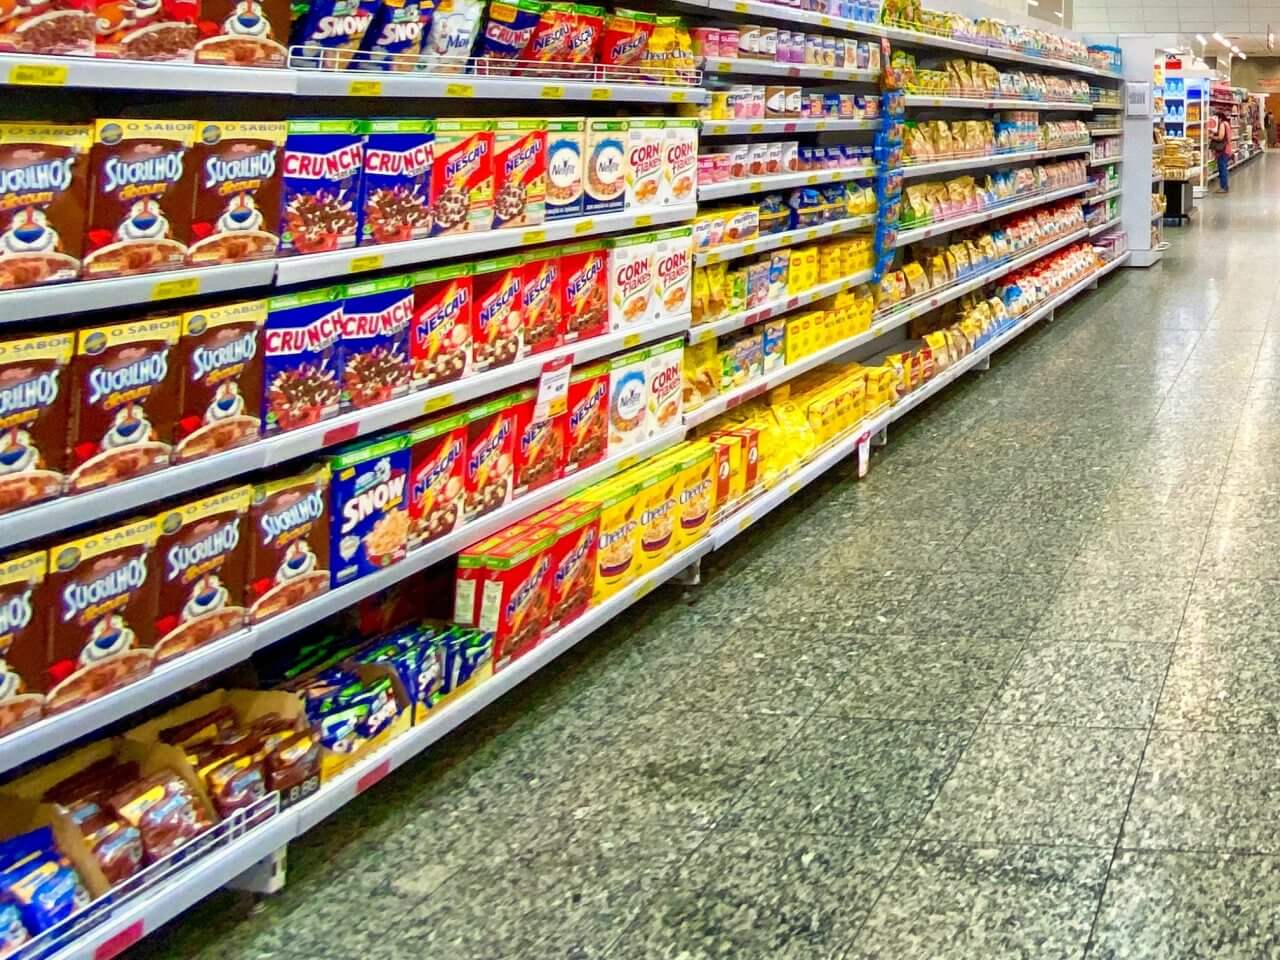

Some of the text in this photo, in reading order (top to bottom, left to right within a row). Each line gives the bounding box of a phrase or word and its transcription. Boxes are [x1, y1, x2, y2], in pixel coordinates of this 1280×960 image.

[314, 14, 373, 41] SNOW
[487, 24, 533, 43] CRUNC
[533, 25, 570, 52] NESCAU
[0, 154, 75, 191] UCRILHOS
[105, 150, 184, 191] SUCRILHOS
[206, 149, 277, 188] SUCRILHOS
[285, 143, 363, 177] CRUNCH
[366, 144, 434, 175] CRUNCH
[445, 141, 488, 177] NESCAU
[505, 141, 542, 173] NESCAU
[630, 142, 660, 166] CORN
[667, 142, 695, 165] CORN
[566, 259, 603, 300] NESCAU
[617, 260, 648, 287] CORN
[658, 251, 687, 277] CORN
[343, 296, 413, 338] CRUNCH
[416, 289, 468, 342] NESCAU
[479, 280, 520, 325] NESCAU
[267, 310, 342, 354] CRUNCH
[90, 350, 169, 403] SUCRILHOS
[192, 332, 258, 381] SUCRILHOS
[651, 365, 680, 392] CORN
[569, 381, 607, 430] NESCAU
[469, 419, 512, 473] NESCAU
[413, 441, 463, 501] NESCAU
[679, 476, 712, 505] Cheerios
[261, 489, 324, 544] SUCRILHOS
[342, 475, 408, 533] SNOW
[640, 496, 677, 526] Cheerios
[167, 518, 241, 581] SUCRILHOS
[554, 528, 596, 585] NESCAU
[64, 552, 148, 622] SUCRILHOS
[506, 554, 551, 618] NESCAU
